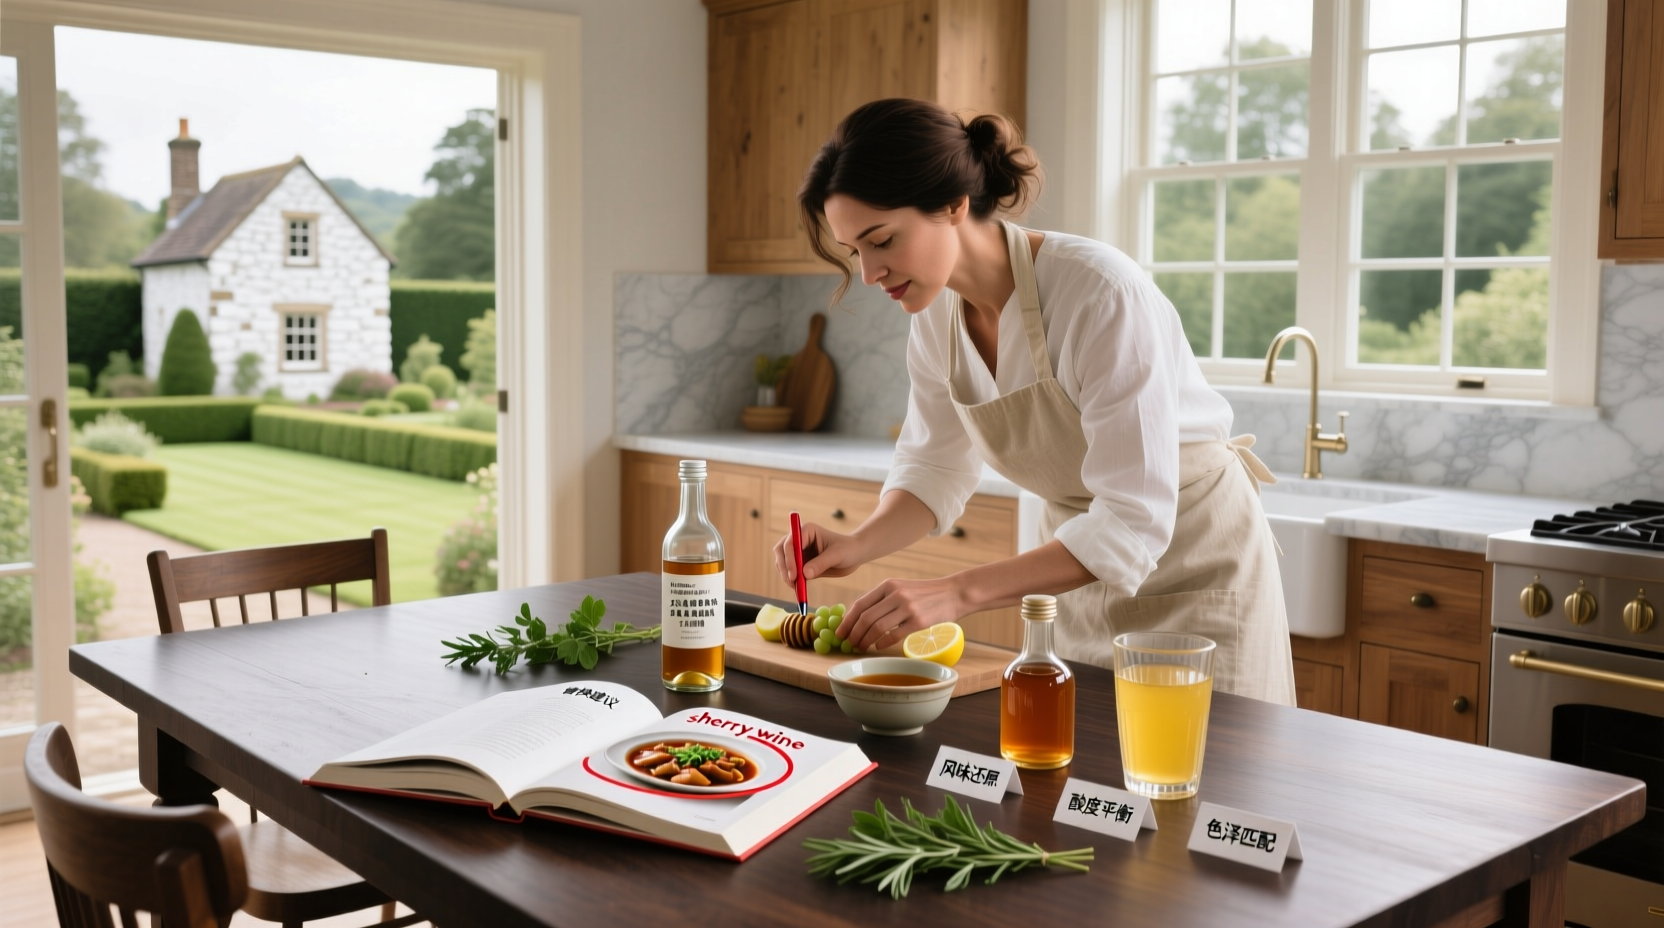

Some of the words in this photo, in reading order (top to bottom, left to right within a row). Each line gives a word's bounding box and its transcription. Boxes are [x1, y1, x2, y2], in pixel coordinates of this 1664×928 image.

[686, 711, 755, 737] sherry
[758, 727, 806, 751] wine
[1206, 817, 1278, 854] 色泽匹配
